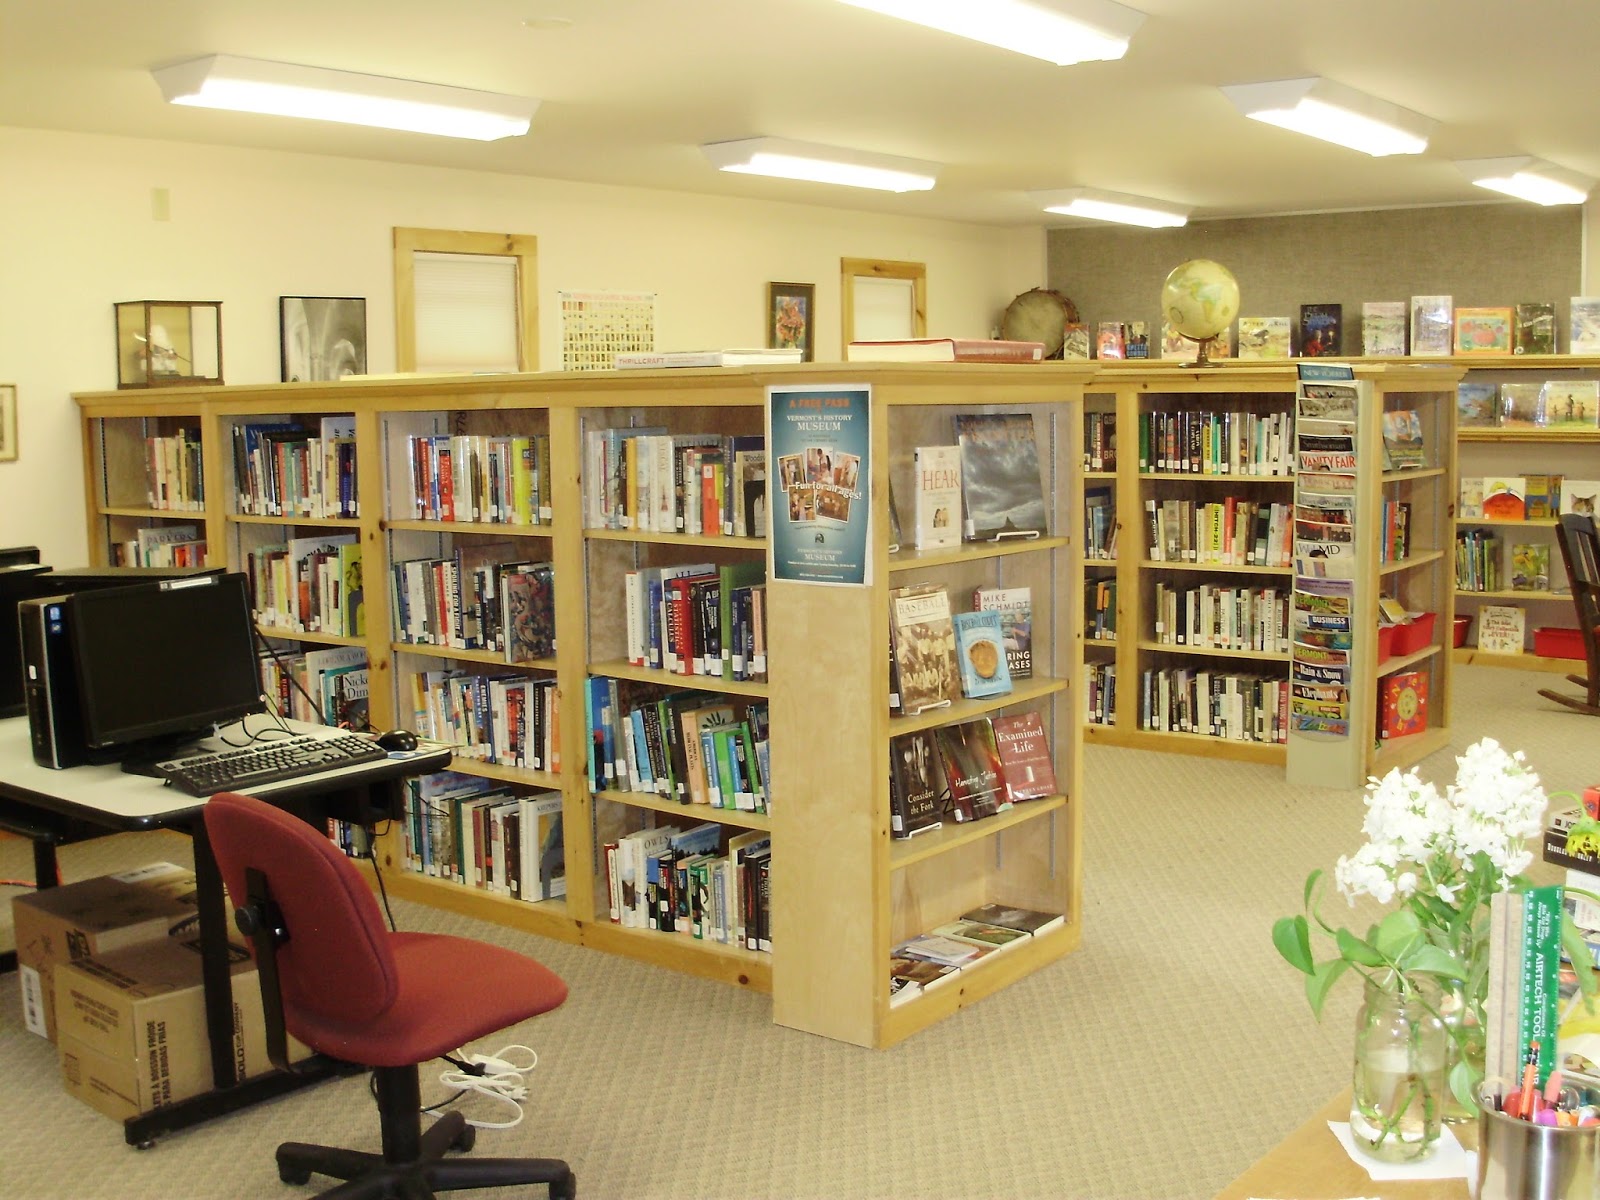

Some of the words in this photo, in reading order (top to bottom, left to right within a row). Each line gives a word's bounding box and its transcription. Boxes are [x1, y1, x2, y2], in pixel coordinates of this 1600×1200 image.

[618, 357, 665, 366] THRILLCRAFT
[797, 422, 841, 431] MUSEUM
[1302, 456, 1334, 468] VANITY
[1336, 455, 1356, 468] FAIR
[922, 470, 960, 491] HEAR
[804, 554, 835, 562] MUSEUM
[983, 593, 1006, 603] MIKE
[898, 597, 946, 615] BASEBALL
[983, 601, 1028, 611] SCHMIDT
[667, 602, 675, 643] CALCULUS
[1312, 616, 1346, 625] BUSINESS
[1007, 651, 1030, 660] RING
[1008, 660, 1031, 669] ASES
[1300, 664, 1316, 677] Rain
[1322, 669, 1341, 680] Snow
[345, 674, 368, 686] Nick
[347, 687, 368, 699] Dim
[1301, 687, 1339, 700] Elephants
[1013, 721, 1024, 729] The
[998, 726, 1043, 742] Examined
[1013, 741, 1034, 753] Life
[907, 789, 935, 804] Consider
[910, 804, 919, 815] the
[920, 800, 935, 812] Fork
[644, 834, 669, 849] OWLS
[1533, 952, 1544, 1004] AIRTECH
[1532, 1008, 1542, 1040] TOOL
[146, 1021, 156, 1048] FROIDE
[157, 1021, 167, 1044] FRIAS
[149, 1050, 159, 1082] BOISSON
[159, 1045, 169, 1078] BEBIDAS
[236, 1048, 246, 1081] SOLO
[161, 1078, 170, 1100] PARA
